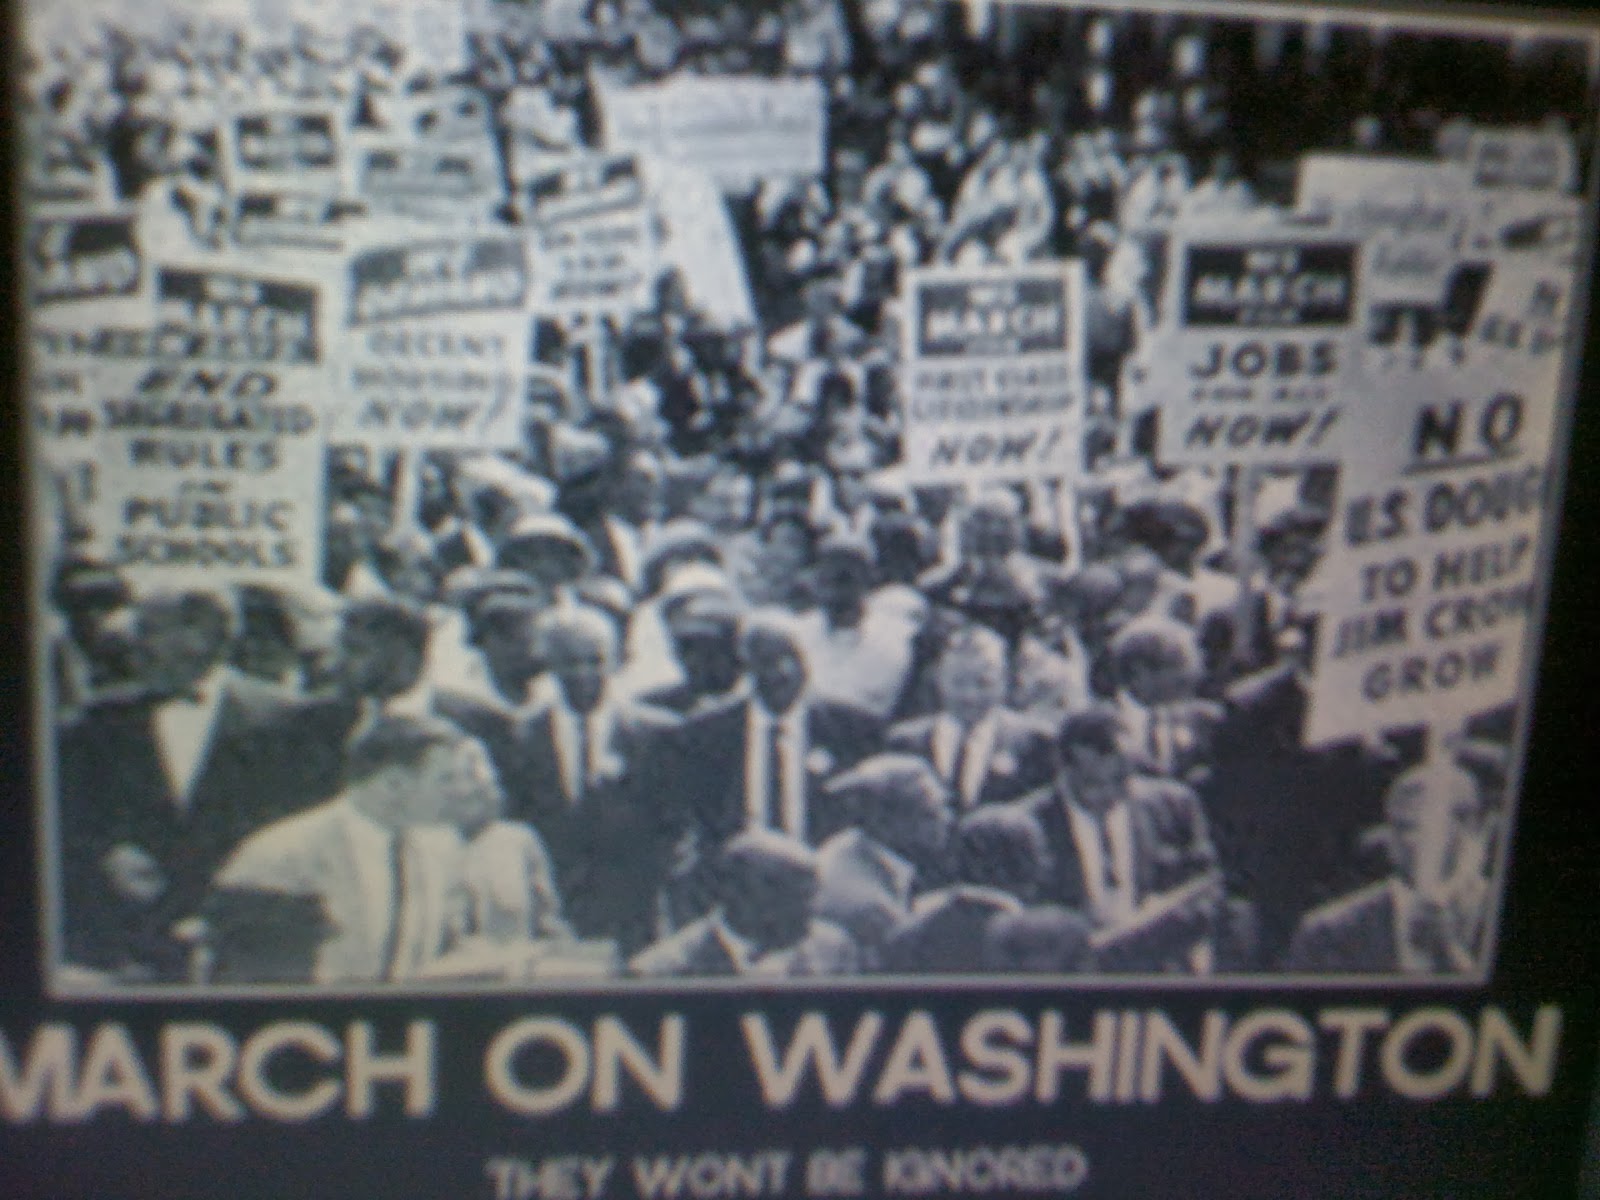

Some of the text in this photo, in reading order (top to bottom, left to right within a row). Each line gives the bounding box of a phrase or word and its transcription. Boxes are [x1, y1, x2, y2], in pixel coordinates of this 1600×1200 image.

[1194, 274, 1345, 306] MARCH
[1189, 341, 1337, 381] JOBS
[1185, 404, 1345, 449] NOW!
[1412, 391, 1526, 457] NO
[122, 497, 295, 532] PUBLIC
[1360, 558, 1420, 603] TO
[1361, 643, 1501, 704] GROW
[0, 1006, 1564, 1124] MARCH ON WASHINGTON
[486, 1144, 1088, 1200] THEY WONT BE IGNORED
